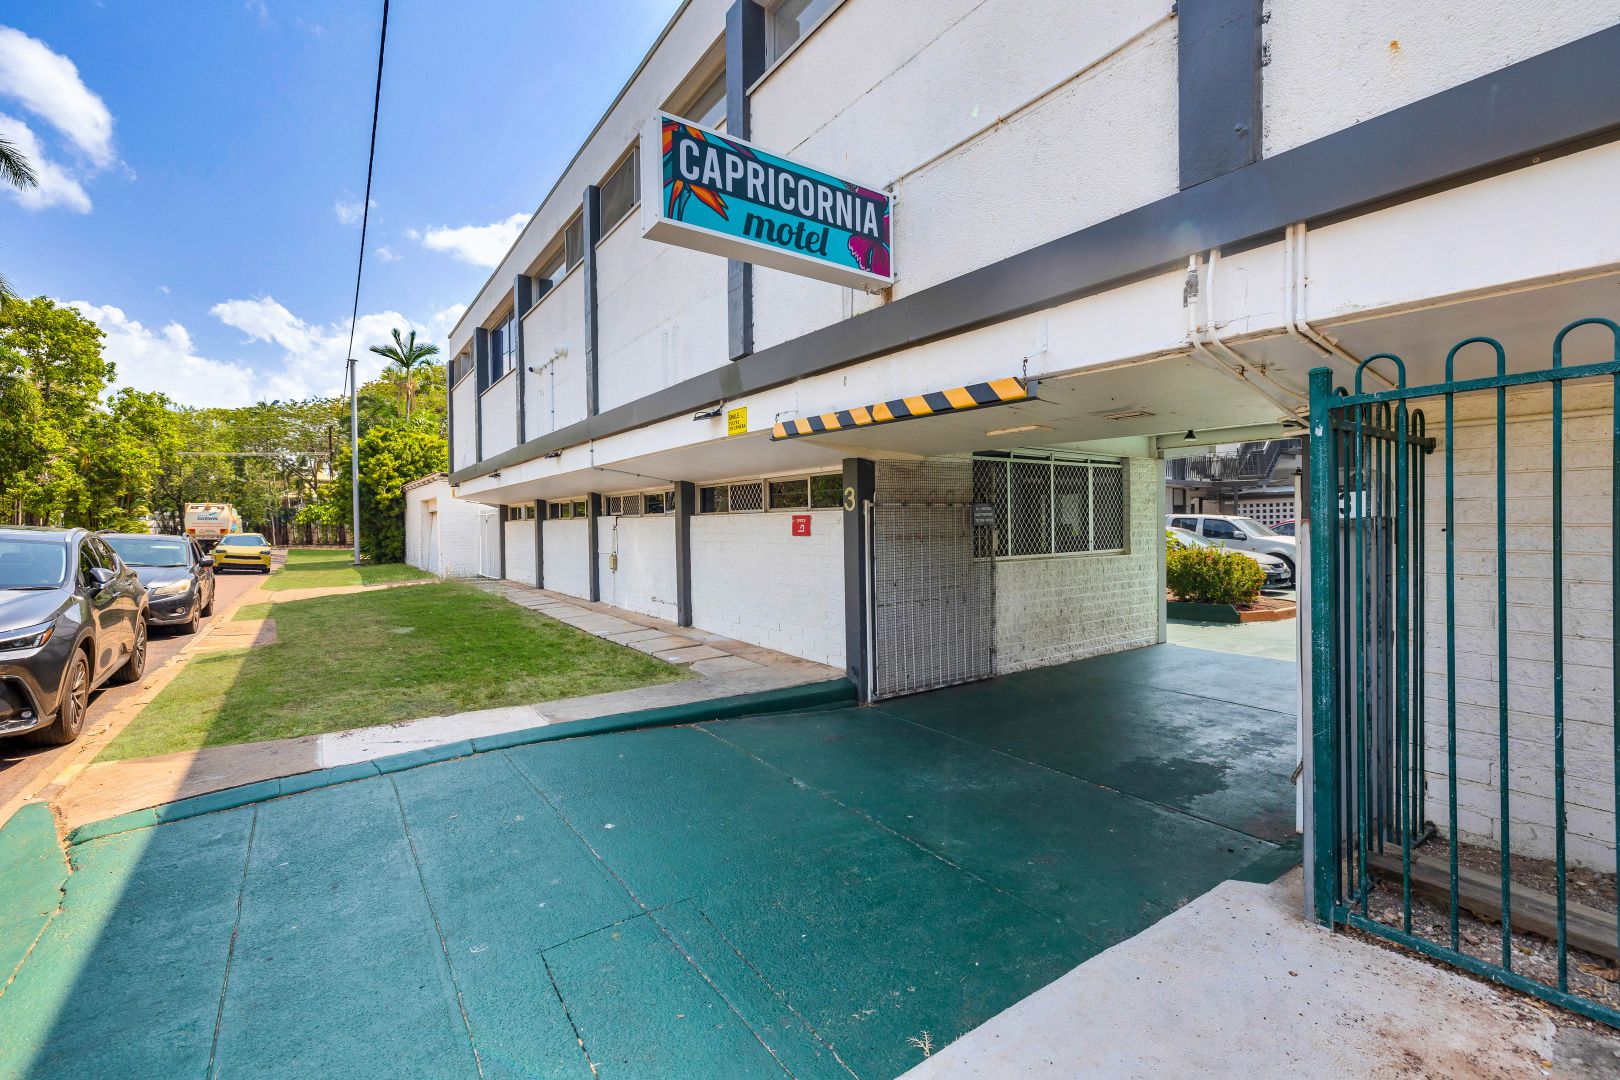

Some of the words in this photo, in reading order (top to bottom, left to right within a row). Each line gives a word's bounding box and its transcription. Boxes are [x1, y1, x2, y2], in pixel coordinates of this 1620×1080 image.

[679, 138, 879, 238] CAPRICORNIA
[743, 212, 829, 257] motel
[844, 487, 856, 511] 3
